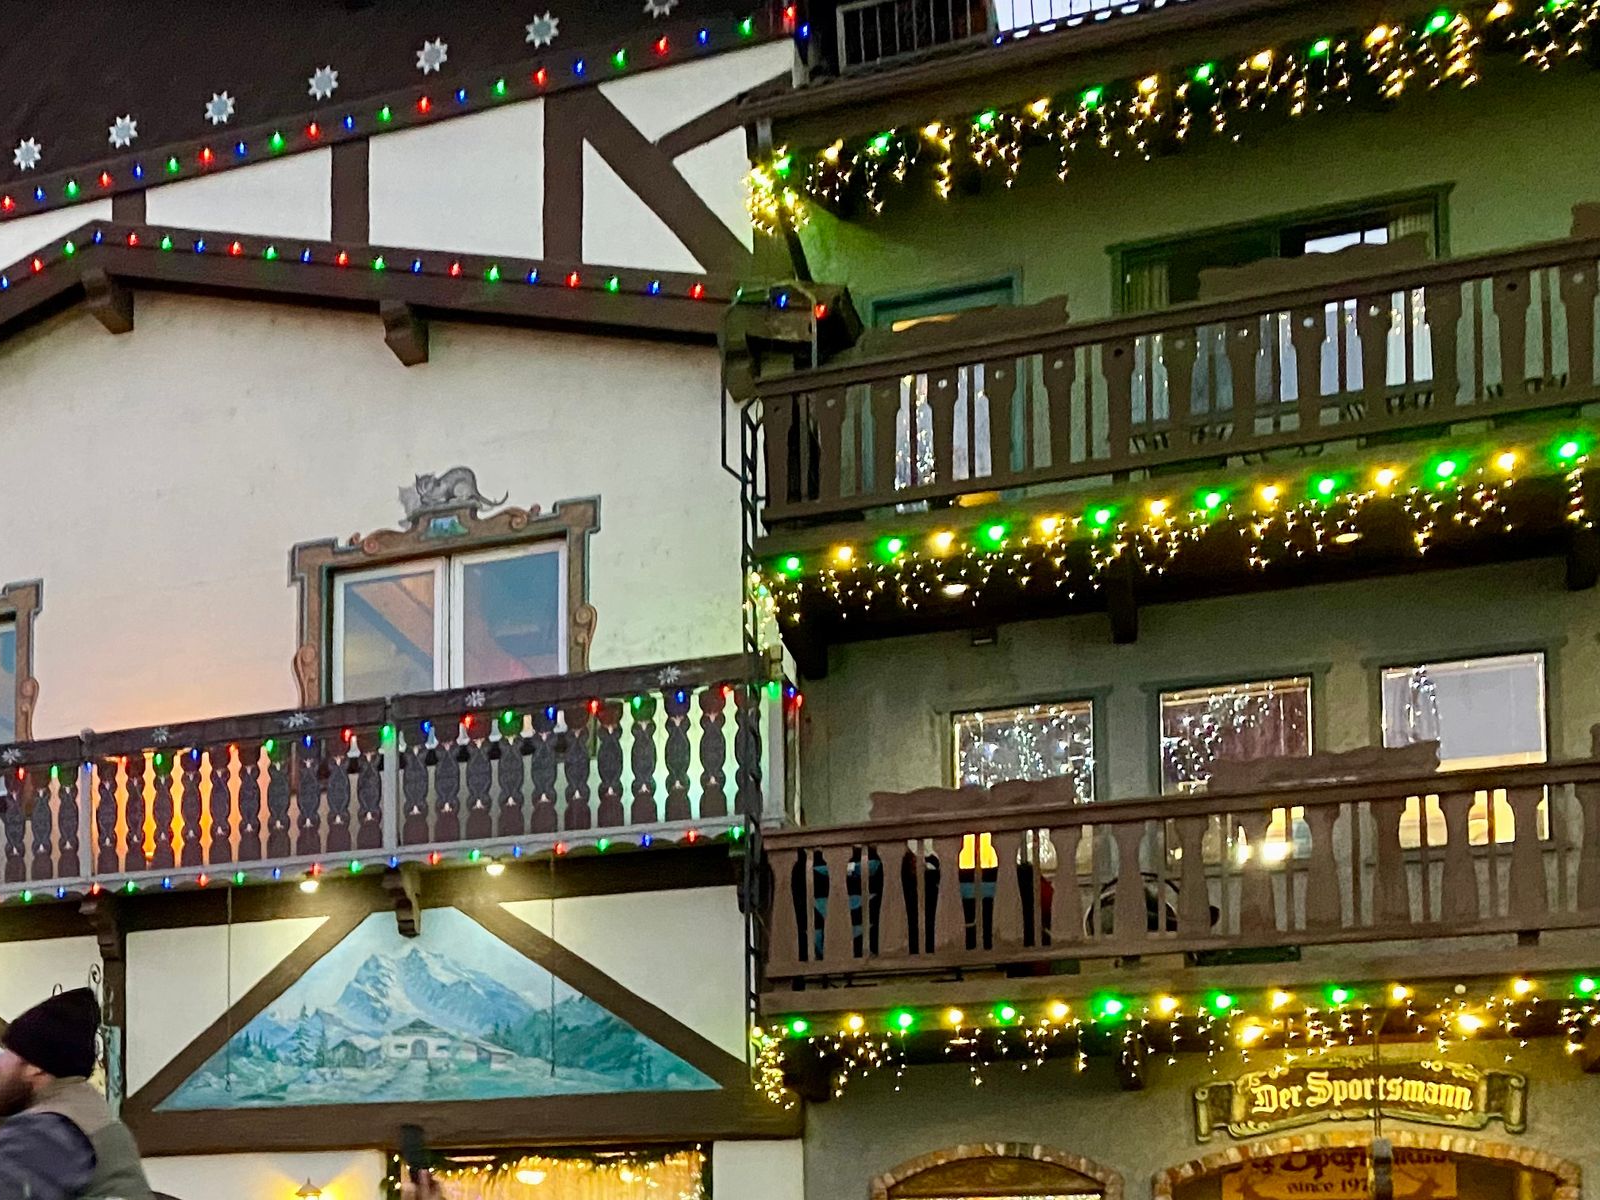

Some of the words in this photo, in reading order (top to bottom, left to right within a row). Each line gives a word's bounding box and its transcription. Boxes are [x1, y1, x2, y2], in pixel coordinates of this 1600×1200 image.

[1250, 1084, 1303, 1113] Der
[1306, 1070, 1474, 1111] Sportsmann
[1341, 1178, 1368, 1193] 197
